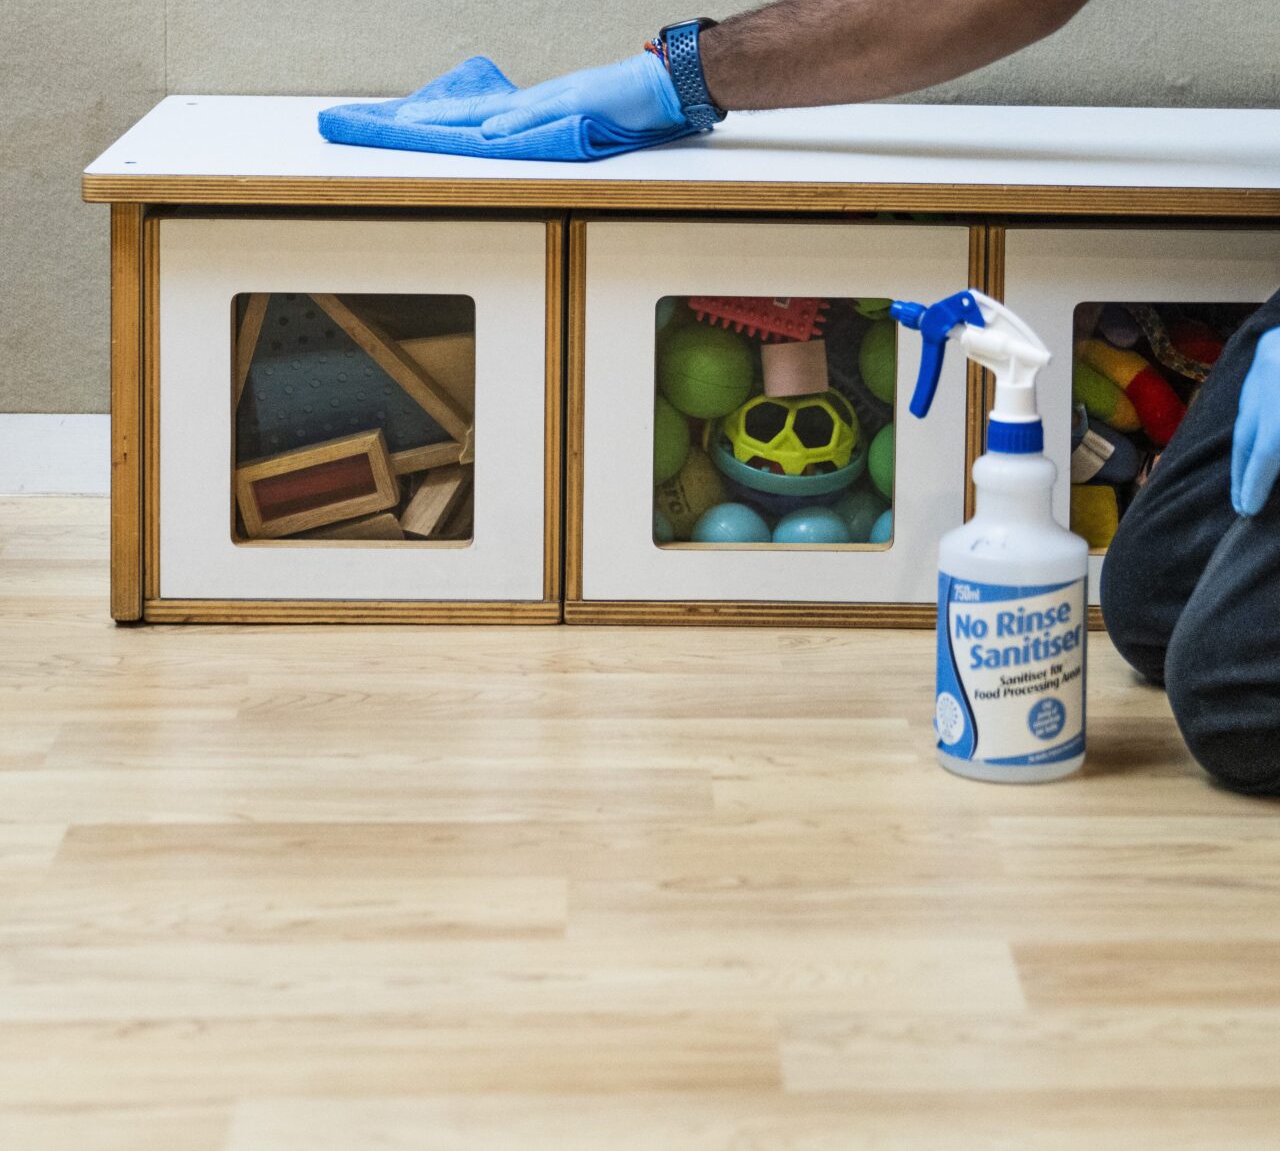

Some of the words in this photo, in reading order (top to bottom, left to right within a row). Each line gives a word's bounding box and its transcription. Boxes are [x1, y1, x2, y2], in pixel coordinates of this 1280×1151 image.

[955, 613, 988, 640] No
[996, 601, 1072, 638] Rinse
[969, 623, 1082, 670] Sanitiser
[974, 688, 1000, 700] Food
[1003, 678, 1060, 698] Processing
[1000, 669, 1047, 686] Sanitiser
[1050, 663, 1063, 676] for
